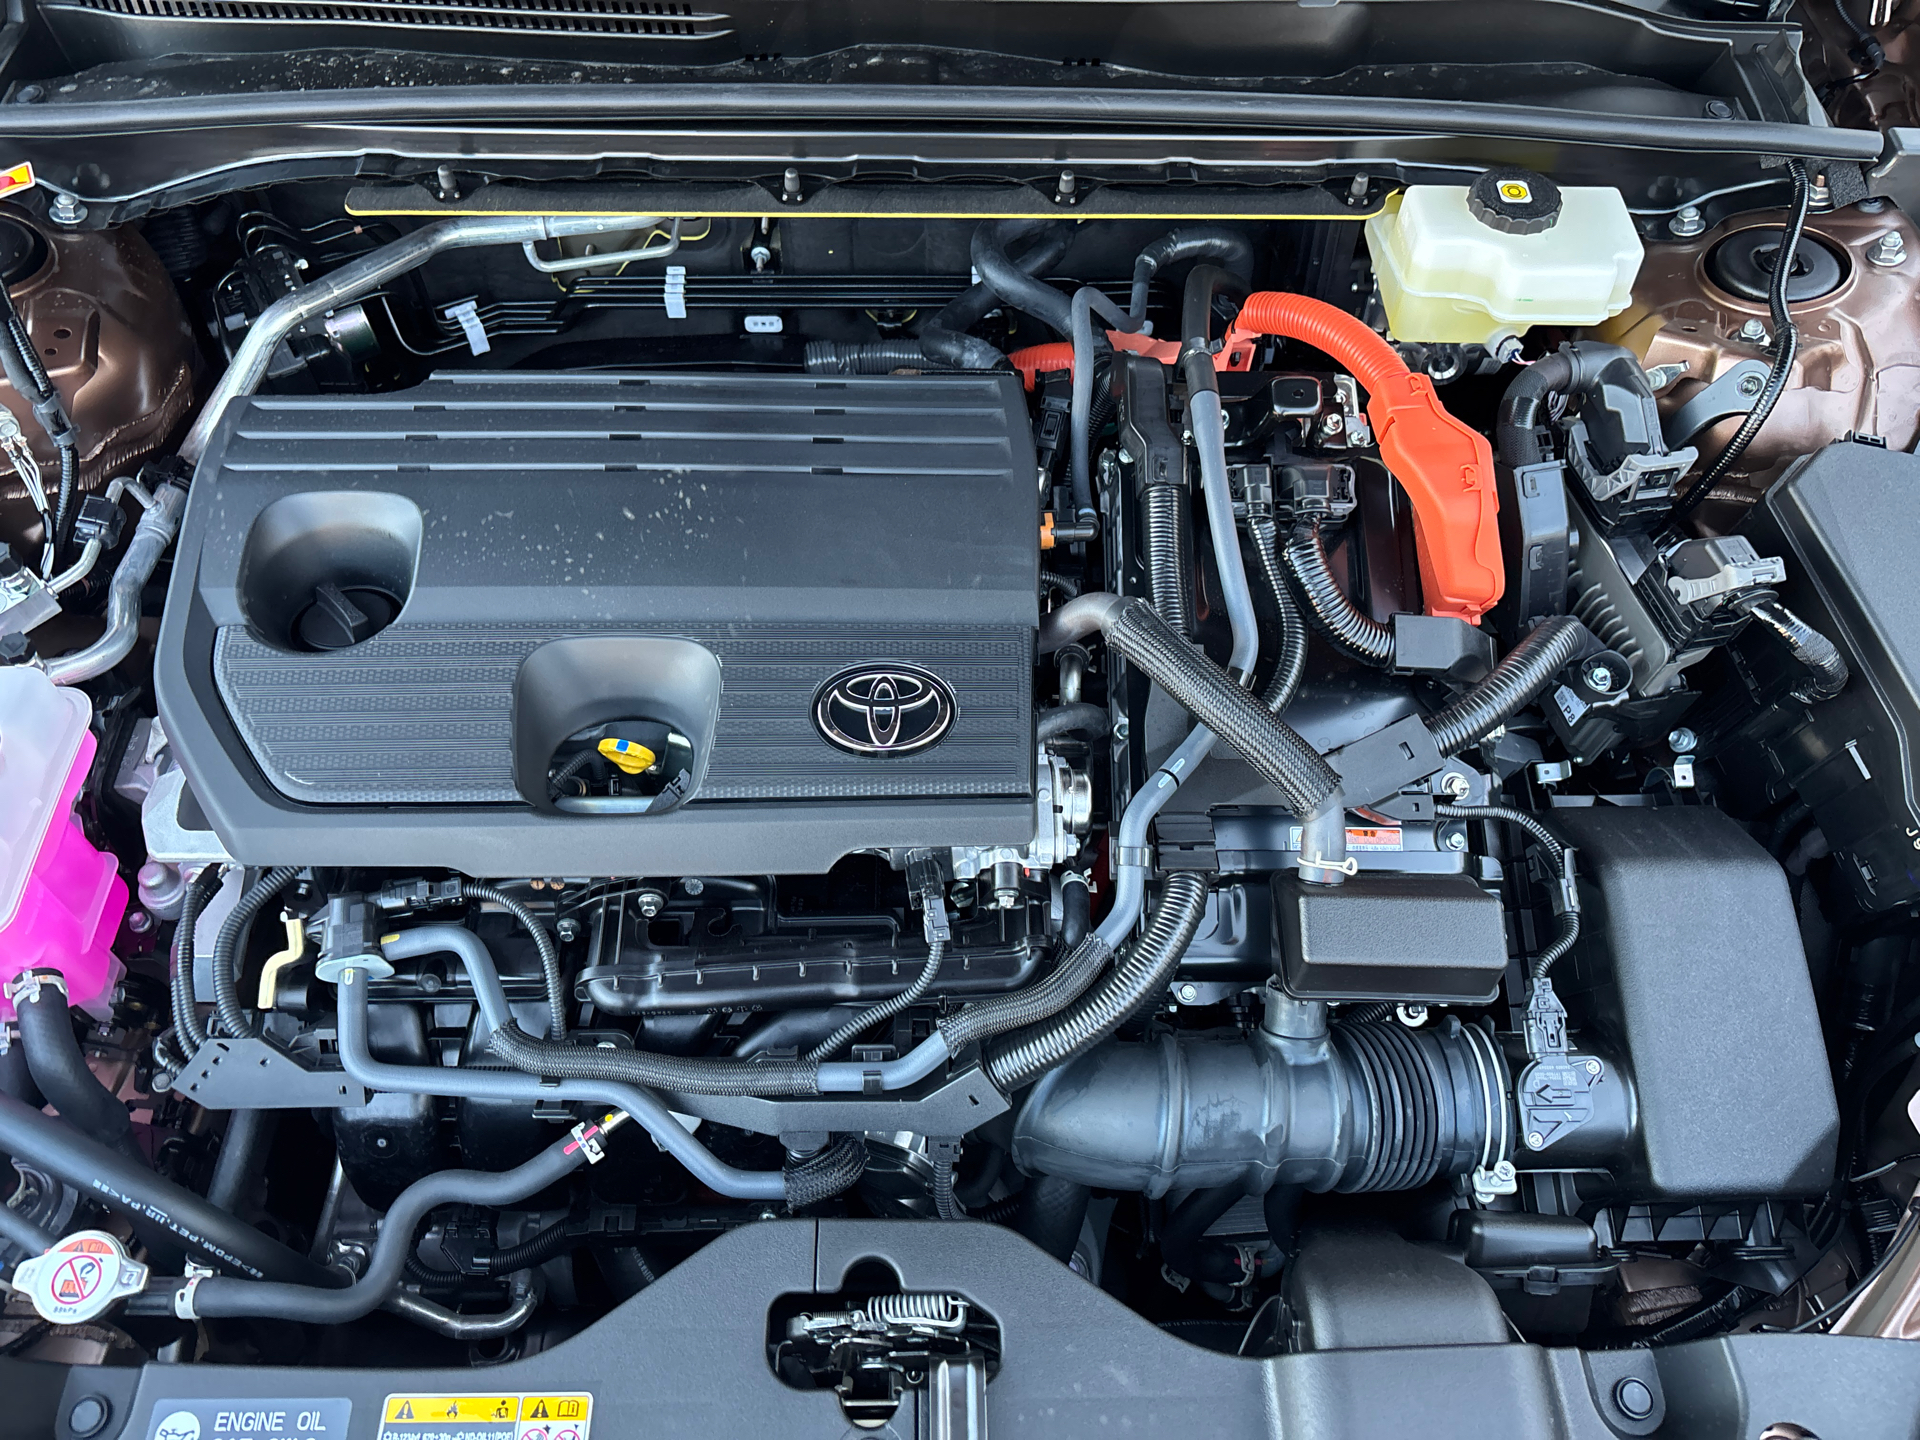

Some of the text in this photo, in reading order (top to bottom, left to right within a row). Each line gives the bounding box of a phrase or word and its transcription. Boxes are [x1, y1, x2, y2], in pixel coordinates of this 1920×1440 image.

[1562, 705, 1576, 723] P8
[214, 1411, 326, 1432] ENGINE OIL
